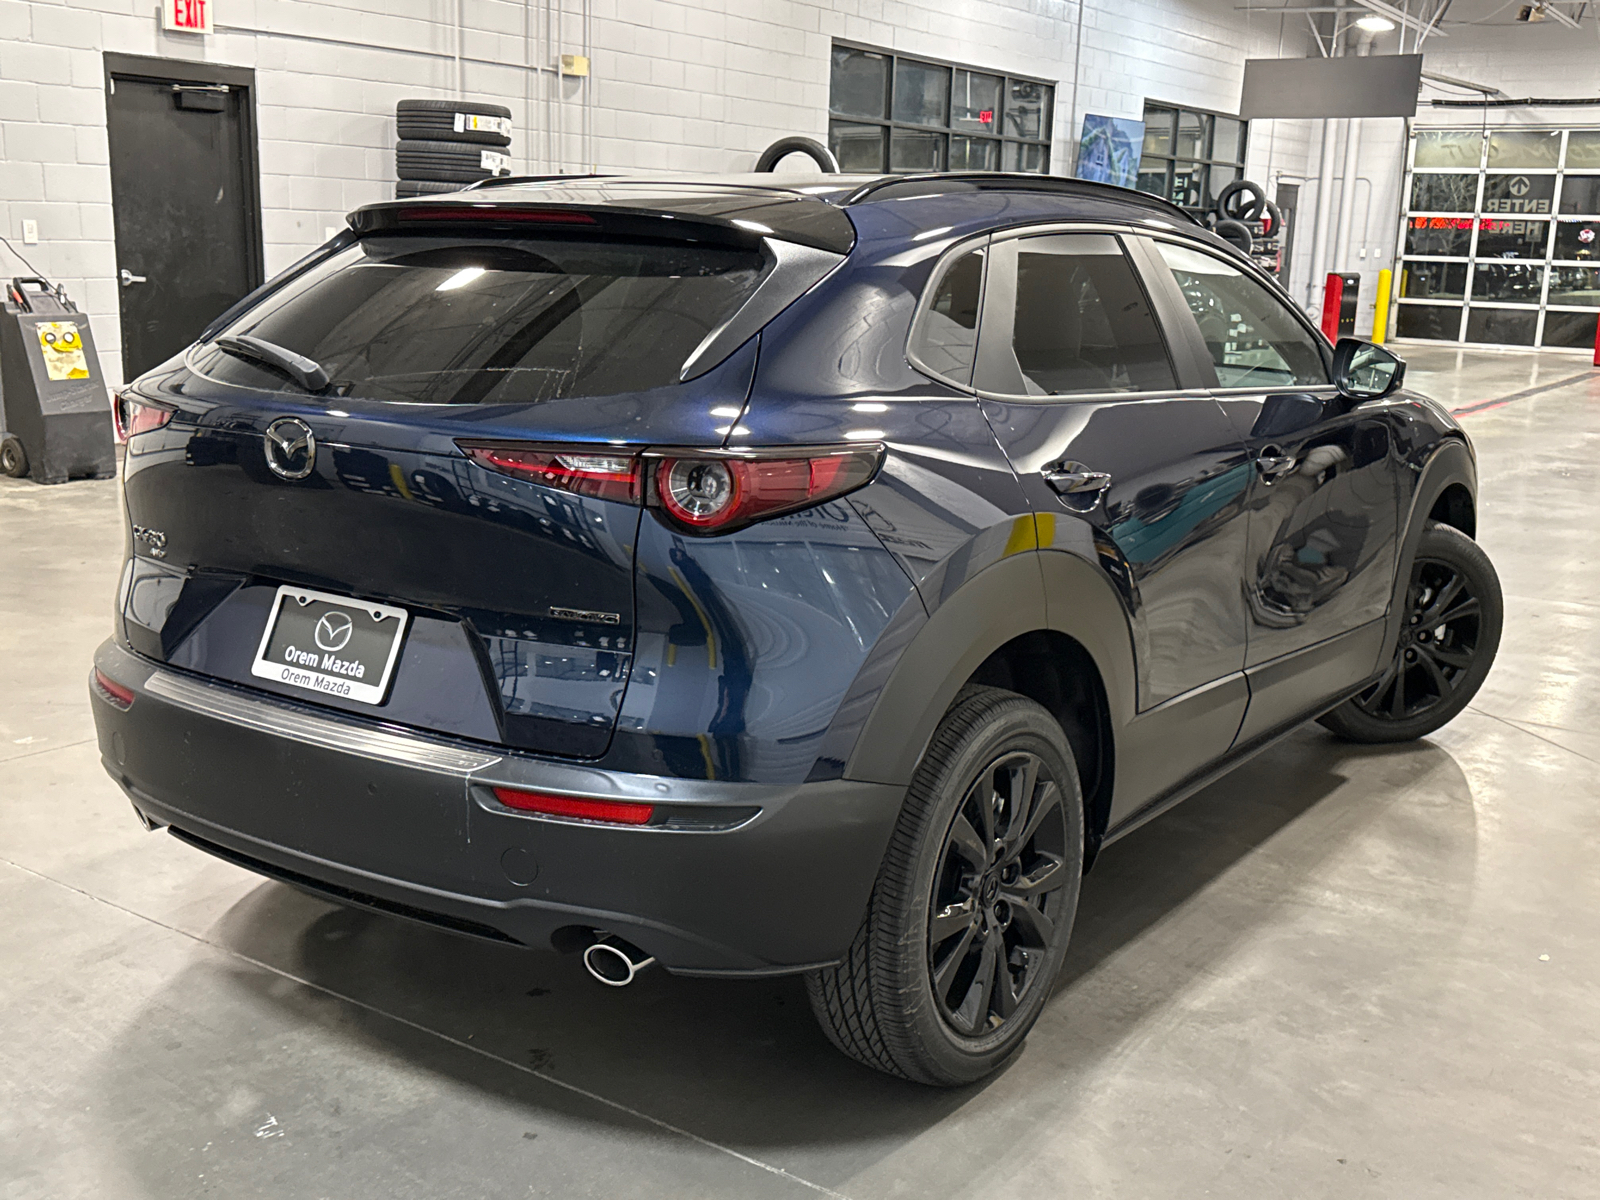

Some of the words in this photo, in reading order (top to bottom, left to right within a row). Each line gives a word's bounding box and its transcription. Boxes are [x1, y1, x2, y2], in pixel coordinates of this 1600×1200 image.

[174, 0, 206, 29] EXIT
[284, 645, 319, 668] Orem
[321, 653, 366, 679] Mazda
[281, 668, 311, 686] Orem
[313, 676, 352, 696] Mazda
